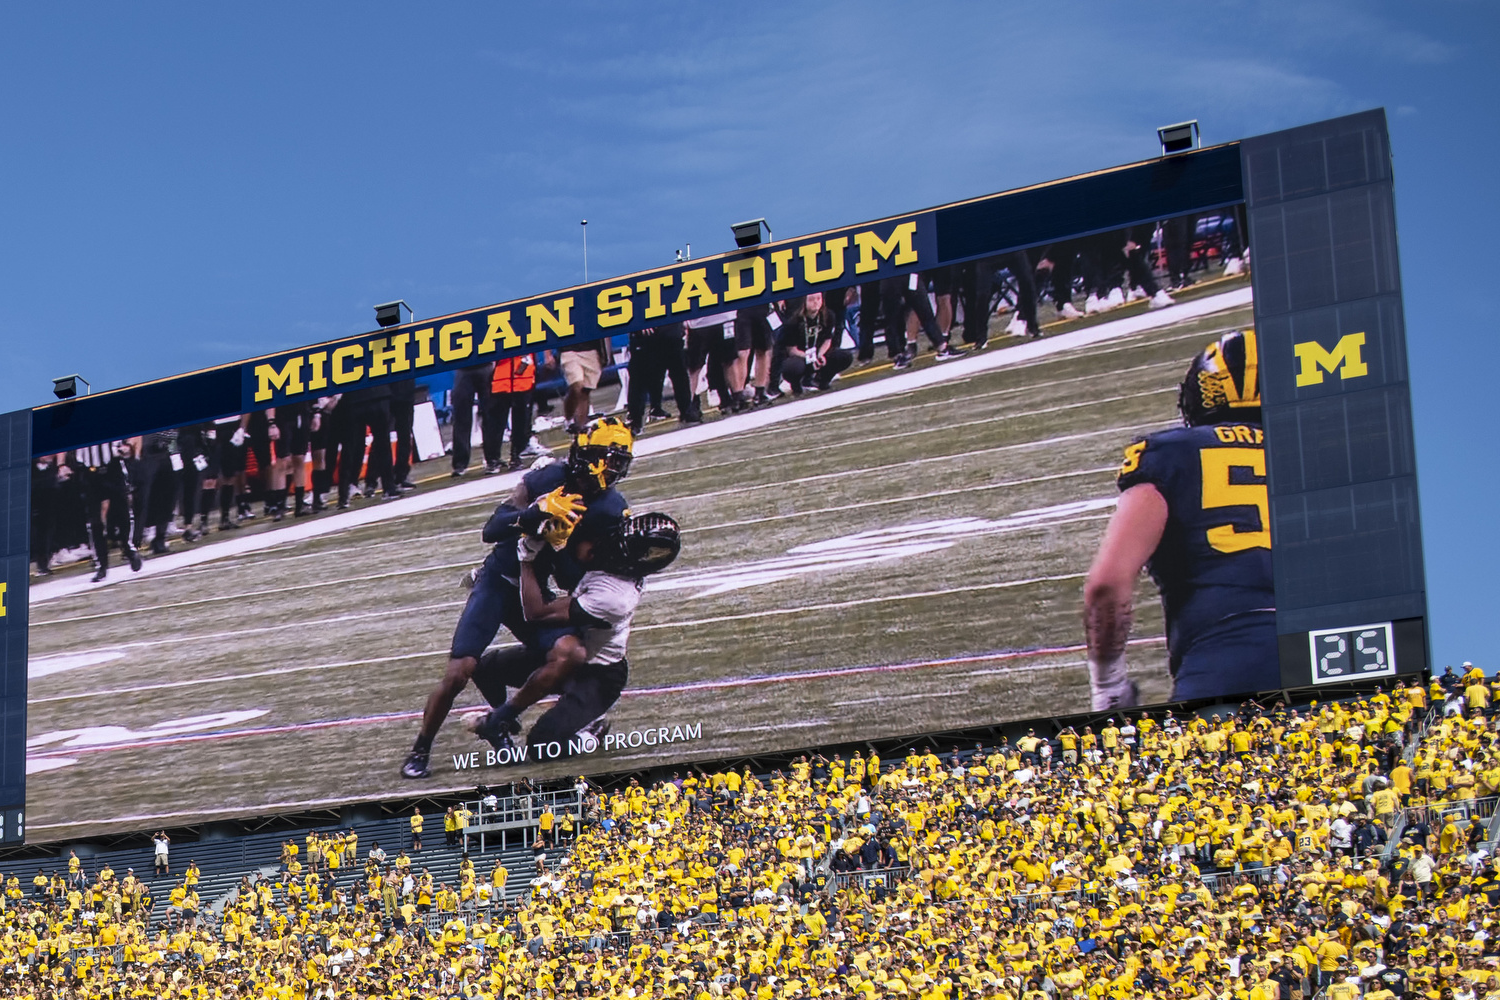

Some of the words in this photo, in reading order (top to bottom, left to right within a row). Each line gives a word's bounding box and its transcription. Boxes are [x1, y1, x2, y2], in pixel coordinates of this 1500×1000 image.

[254, 296, 575, 403] MICHIGAN
[597, 221, 918, 328] STADIUM
[1294, 332, 1368, 387] M
[453, 752, 480, 770] WE
[486, 745, 528, 767] BOW
[534, 741, 561, 760] TO
[568, 737, 598, 756] NO
[604, 722, 703, 751] PROGRAM
[1298, 837, 1311, 847] 23
[142, 897, 151, 906] 77
[816, 952, 828, 960] M
